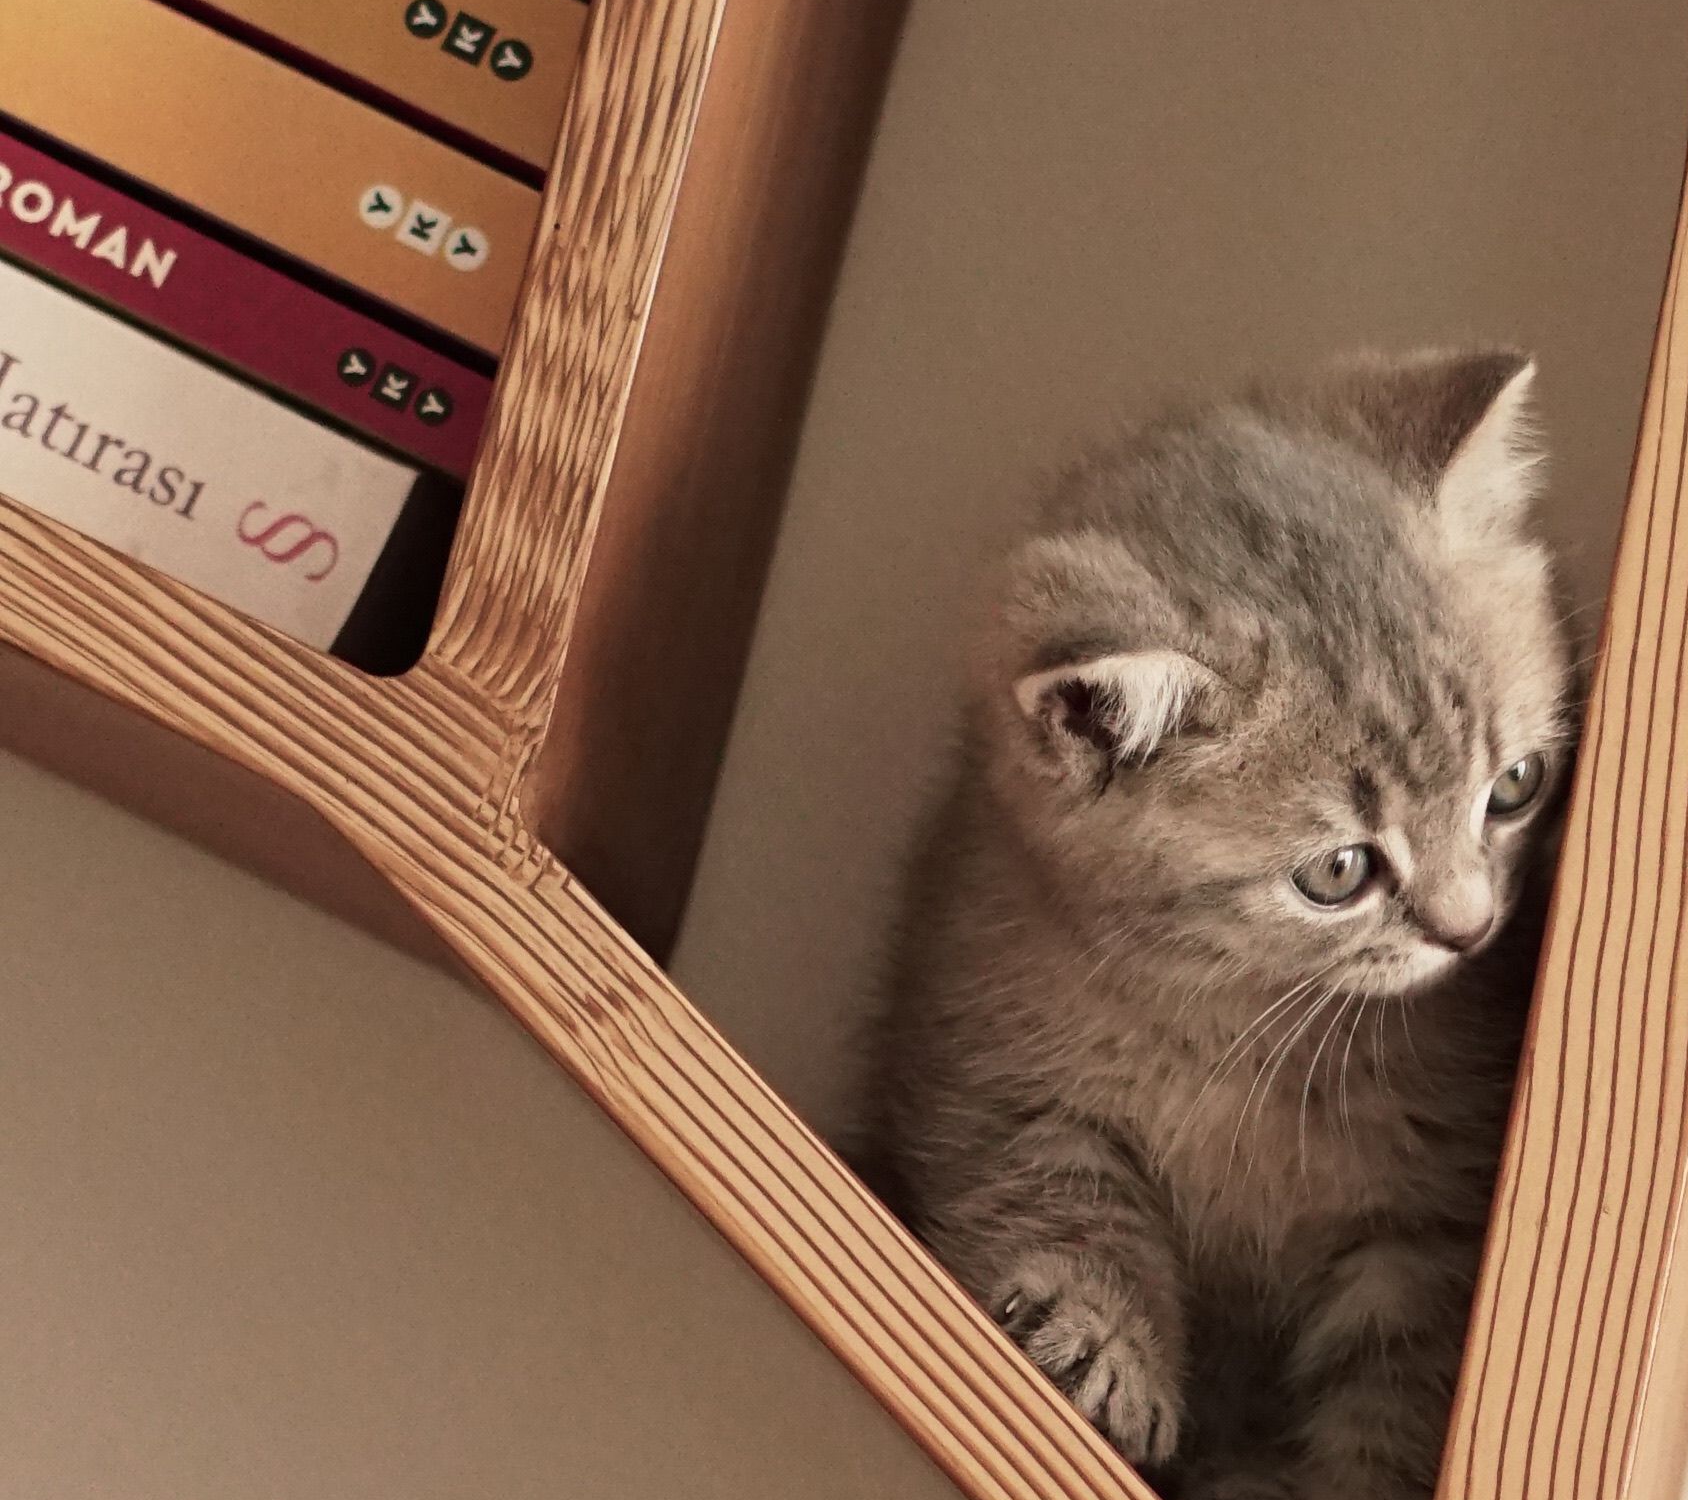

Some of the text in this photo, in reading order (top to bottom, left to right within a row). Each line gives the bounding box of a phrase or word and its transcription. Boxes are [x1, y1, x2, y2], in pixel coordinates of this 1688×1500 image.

[409, 2, 528, 76] YKY
[364, 188, 484, 266] YKY
[342, 351, 449, 421] YKY
